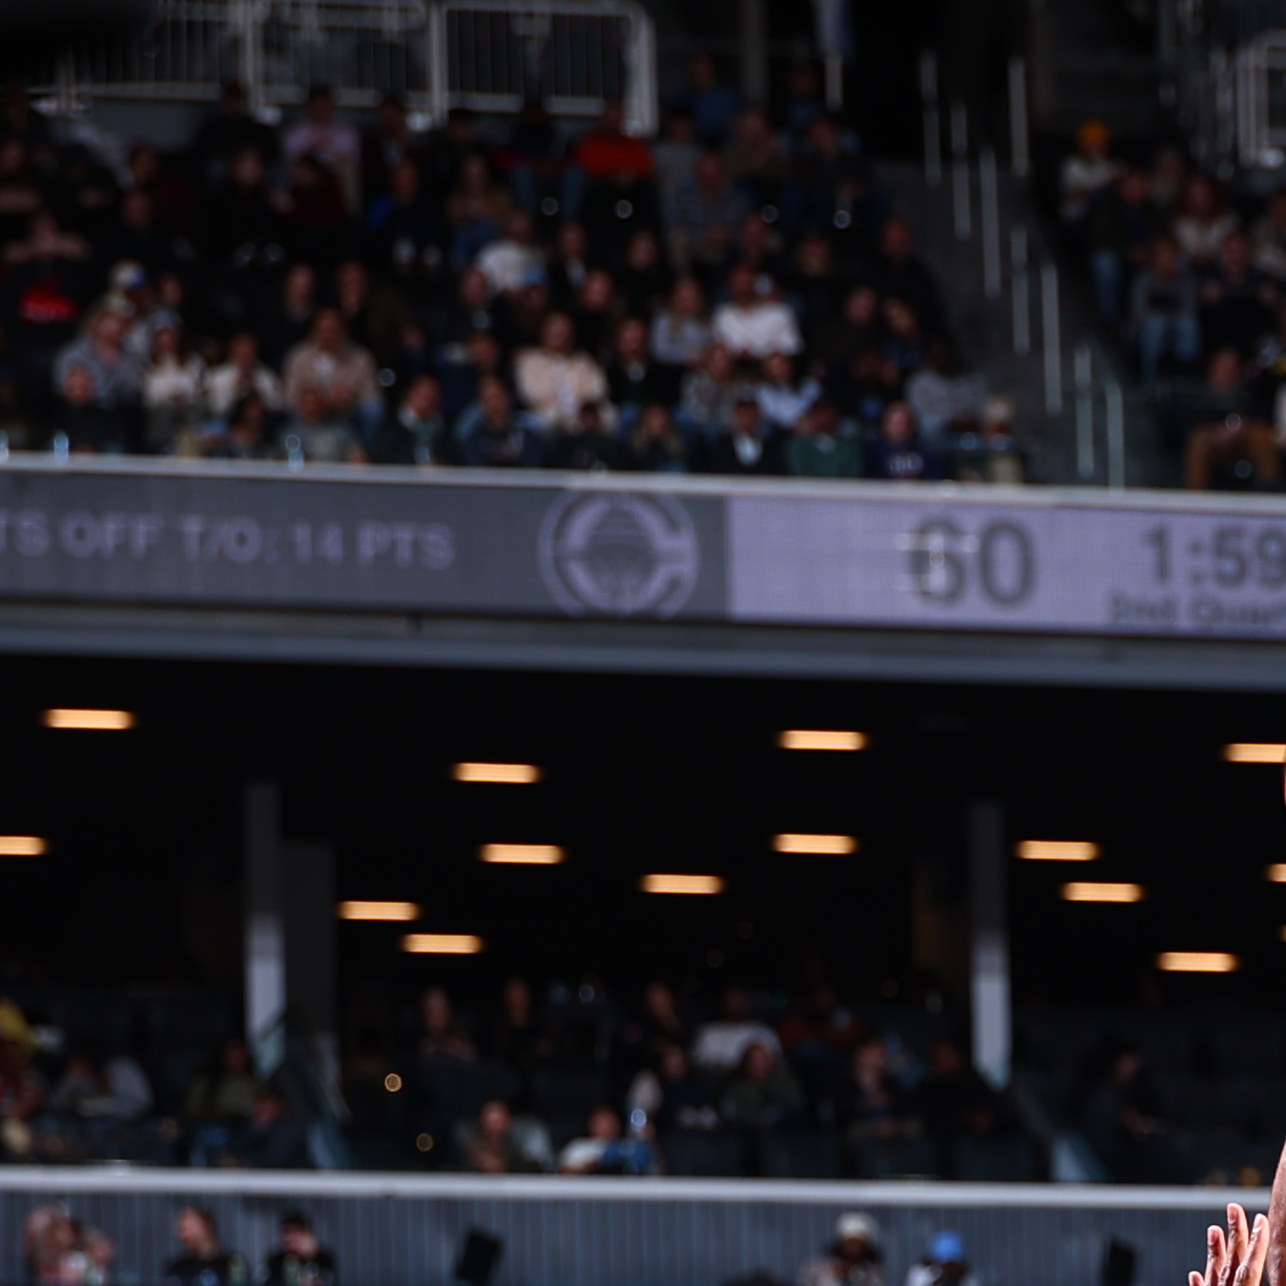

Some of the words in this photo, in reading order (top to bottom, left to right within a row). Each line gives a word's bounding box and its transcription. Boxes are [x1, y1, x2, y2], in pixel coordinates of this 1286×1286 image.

[61, 511, 163, 560] OFF
[294, 520, 344, 567] 14
[357, 520, 455, 571] PTS
[907, 519, 1038, 607] 60
